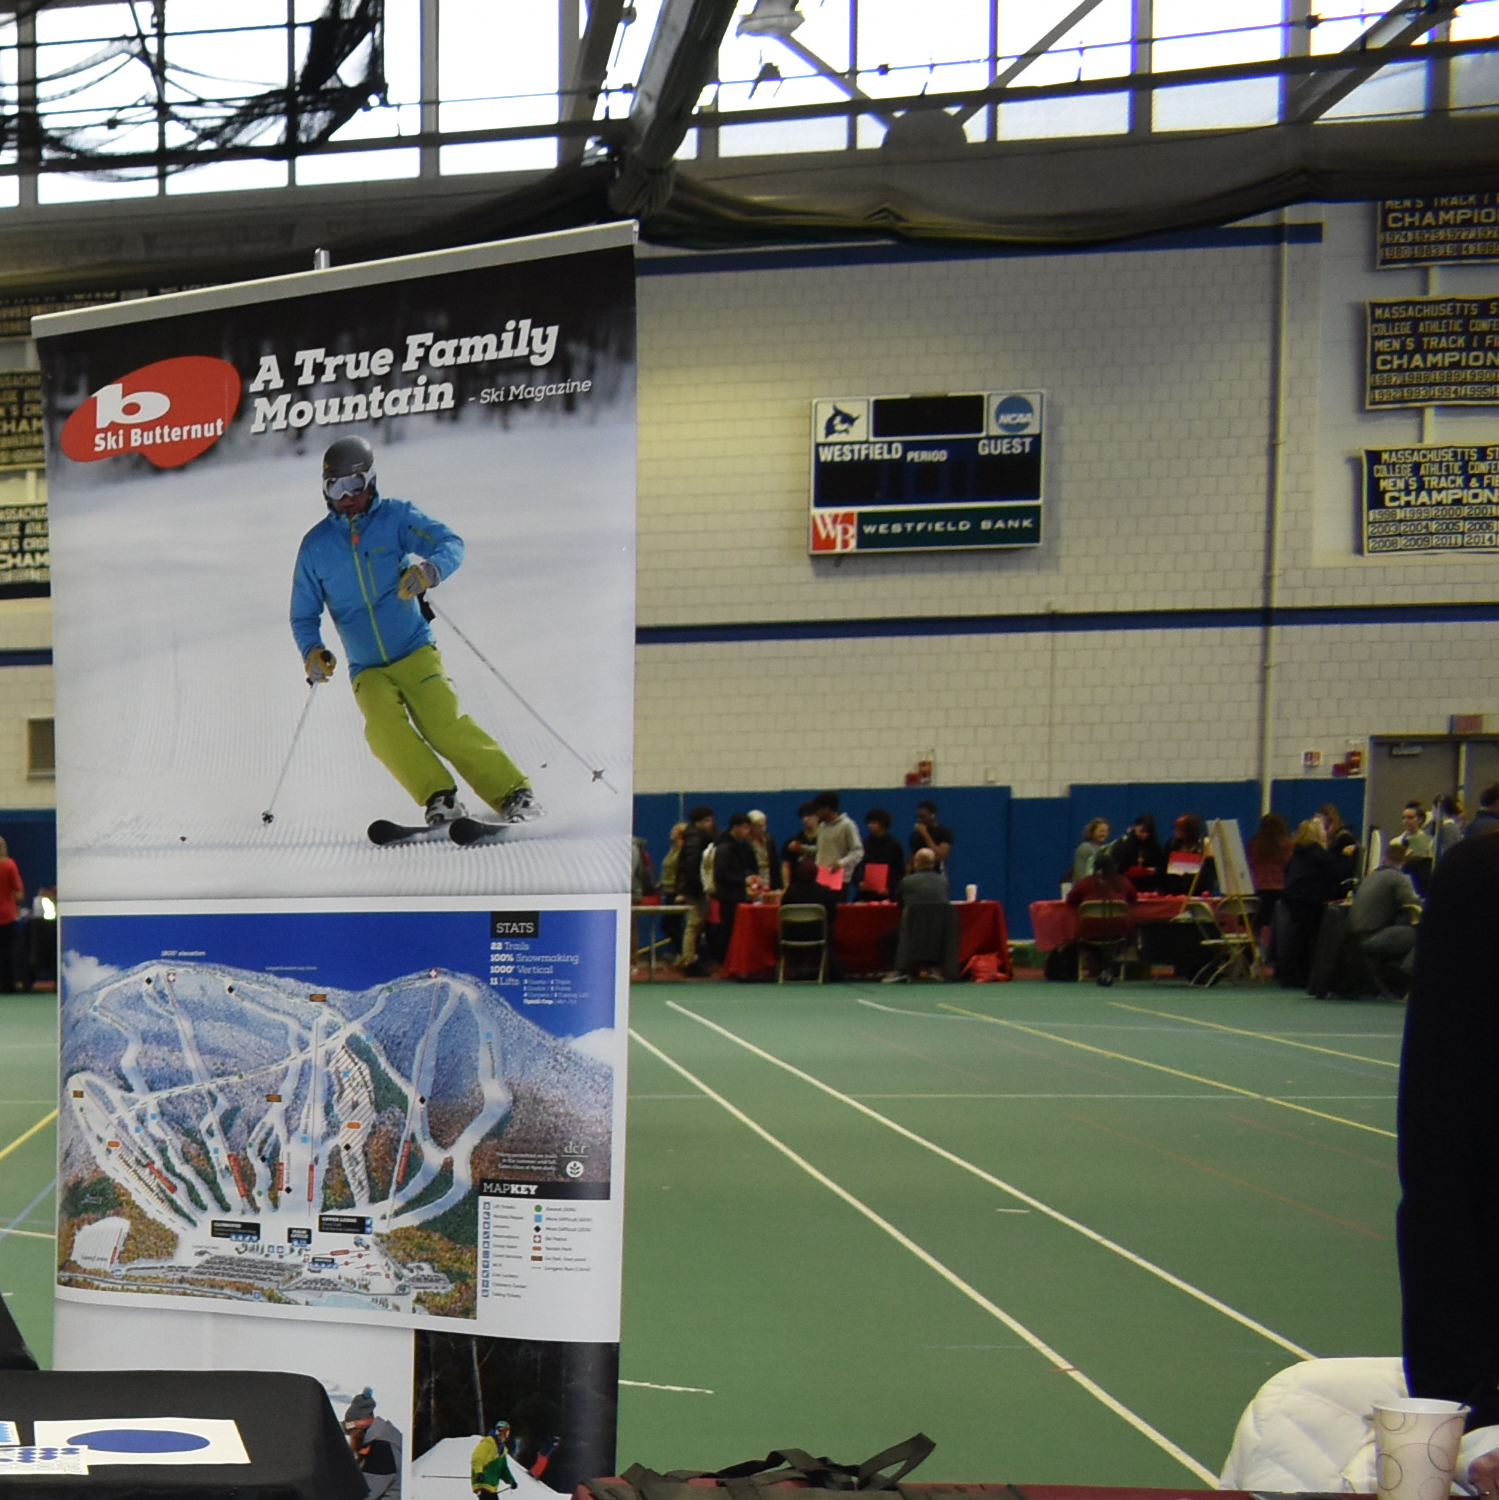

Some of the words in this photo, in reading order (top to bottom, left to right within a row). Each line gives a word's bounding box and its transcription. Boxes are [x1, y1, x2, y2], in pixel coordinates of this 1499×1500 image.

[1374, 303, 1478, 319] MASSACHUSETTS
[1372, 322, 1412, 336] COLLEGE
[1418, 320, 1463, 334] ATHLETIC
[1374, 337, 1414, 351] MEN'S
[1422, 335, 1465, 348] TRACK
[249, 355, 284, 393] A
[294, 346, 394, 385] True
[401, 318, 560, 374] Family
[1431, 386, 1459, 398] 1994
[1463, 385, 1491, 397] 1995
[250, 375, 456, 435] Mountain
[478, 386, 504, 407] Ski
[506, 376, 593, 406] Magazine
[998, 413, 1033, 425] NCAA
[94, 430, 124, 452] Ski
[129, 417, 225, 447] Butternut
[818, 442, 902, 463] WESTFIELD
[906, 450, 948, 463] PERIOD
[978, 438, 1034, 455] GUEST
[1381, 448, 1478, 463] MASSACHUSETTS
[1373, 464, 1413, 478] COLLEGE
[1419, 462, 1463, 475] ATHLETIC
[1379, 477, 1417, 491] MEN'S
[1422, 476, 1464, 489] TRACK
[1469, 477, 1480, 488] &
[1403, 508, 1431, 519] 1999
[1433, 507, 1462, 518] 2000
[1465, 505, 1494, 517] 2001
[862, 520, 971, 535] WESTFIELD
[980, 517, 1034, 531] BANK
[1370, 524, 1399, 535] 2003
[1402, 522, 1430, 534] 2004
[1433, 520, 1461, 532] 2005
[1370, 539, 1399, 550] 2008
[1402, 537, 1430, 548] 2009
[1433, 535, 1460, 546] 2011
[1465, 534, 1494, 545] 2014
[496, 922, 534, 934] STATS
[516, 953, 580, 965] Snowmaking
[564, 1141, 588, 1154] dcr
